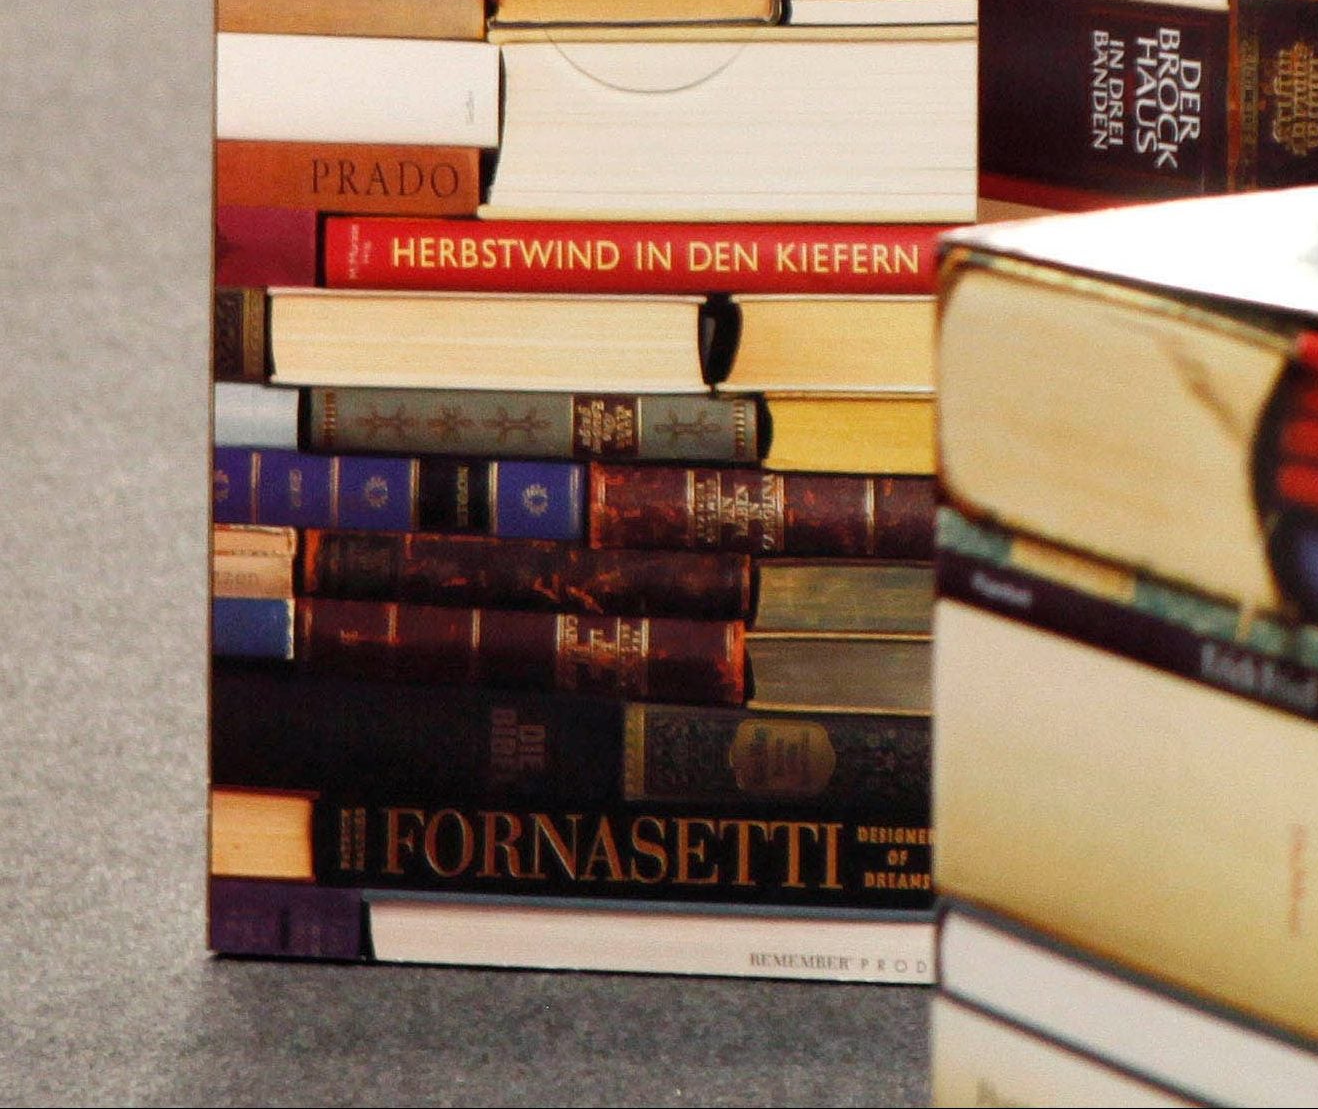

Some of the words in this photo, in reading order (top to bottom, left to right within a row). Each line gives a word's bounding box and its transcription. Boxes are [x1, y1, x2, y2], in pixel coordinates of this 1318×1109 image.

[1108, 40, 1125, 70] IN
[1107, 77, 1124, 147] DREI
[1134, 36, 1159, 155] HAUS
[1155, 27, 1181, 169] BROCK
[1179, 59, 1201, 143] DER
[311, 158, 460, 199] PRADO
[392, 236, 621, 272] HERBSTWIND
[635, 240, 673, 272] IN
[688, 240, 760, 273] DEN
[775, 241, 920, 275] KIEFERN
[382, 807, 844, 891] FORNASETTI
[887, 848, 909, 867] OF
[863, 871, 931, 890] DREAMS
[860, 958, 930, 976] PROD
